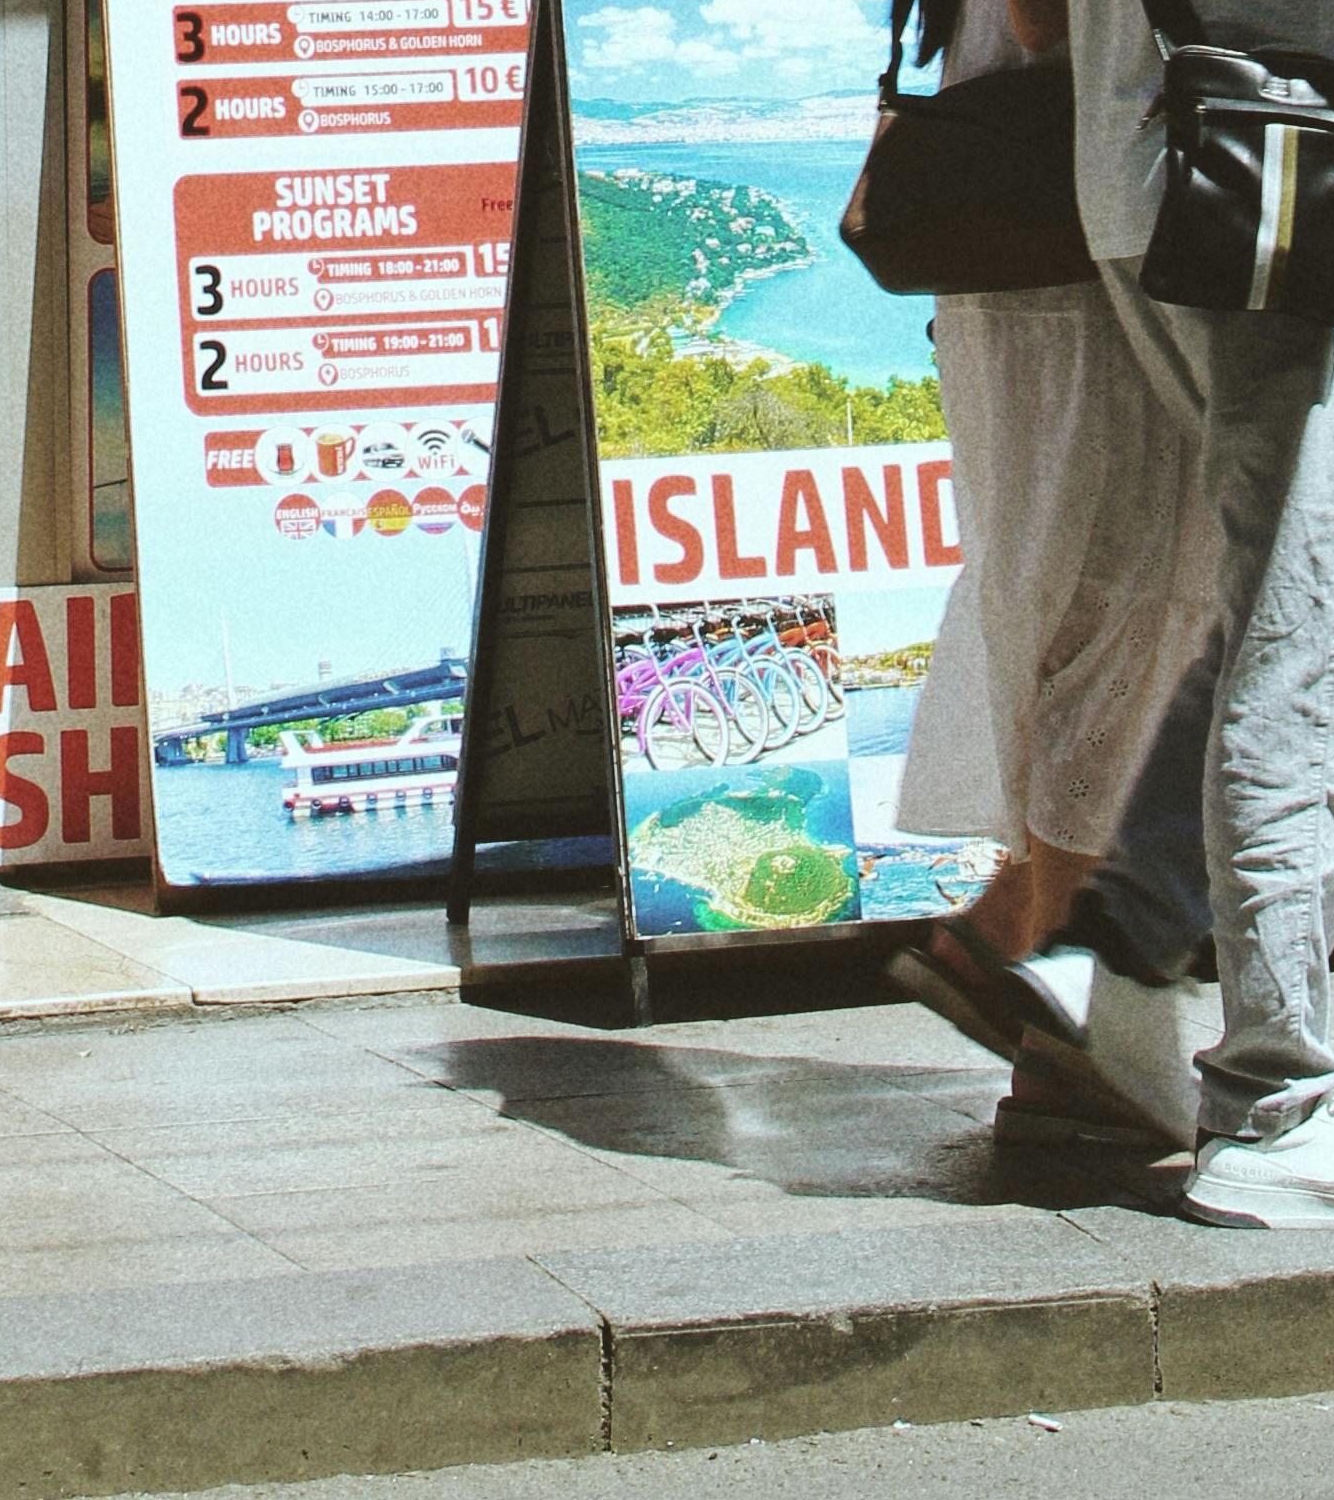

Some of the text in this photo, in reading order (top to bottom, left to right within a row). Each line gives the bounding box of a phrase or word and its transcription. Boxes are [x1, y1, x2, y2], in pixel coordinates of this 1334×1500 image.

[448, 33, 482, 48] HORN
[274, 175, 390, 205] SUNSET
[252, 206, 417, 241] PROGRAMS
[231, 278, 299, 298] HOURS
[430, 333, 464, 348] 21:00
[235, 352, 304, 372] HOURS
